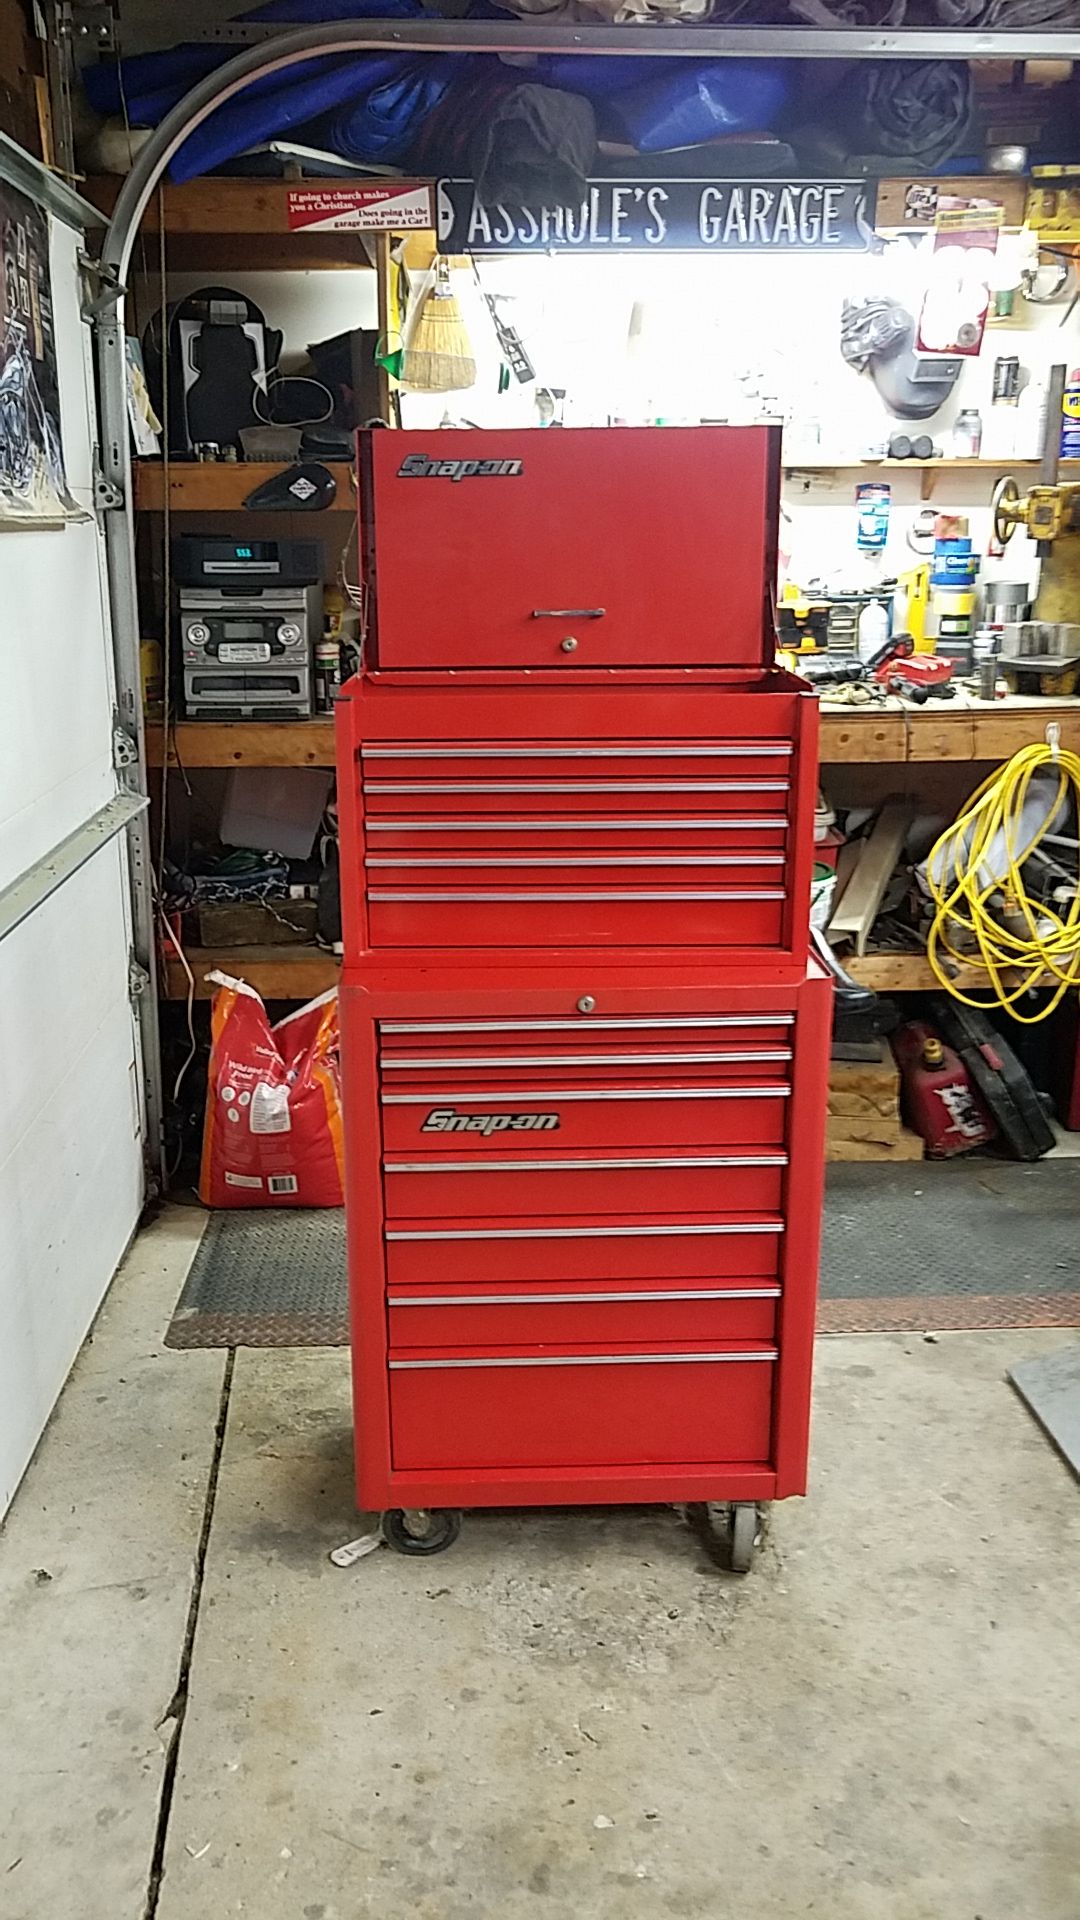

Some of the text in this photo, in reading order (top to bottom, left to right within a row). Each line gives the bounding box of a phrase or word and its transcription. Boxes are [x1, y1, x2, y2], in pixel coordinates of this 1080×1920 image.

[289, 190, 390, 204] If going to church makes
[290, 201, 357, 213] you a Christian.
[358, 207, 428, 218] Does going in the
[700, 186, 845, 244] GARAGE
[334, 220, 360, 229] garage
[362, 217, 385, 227] make
[397, 454, 523, 482] Snap-on
[421, 1110, 560, 1136] Snap-on
